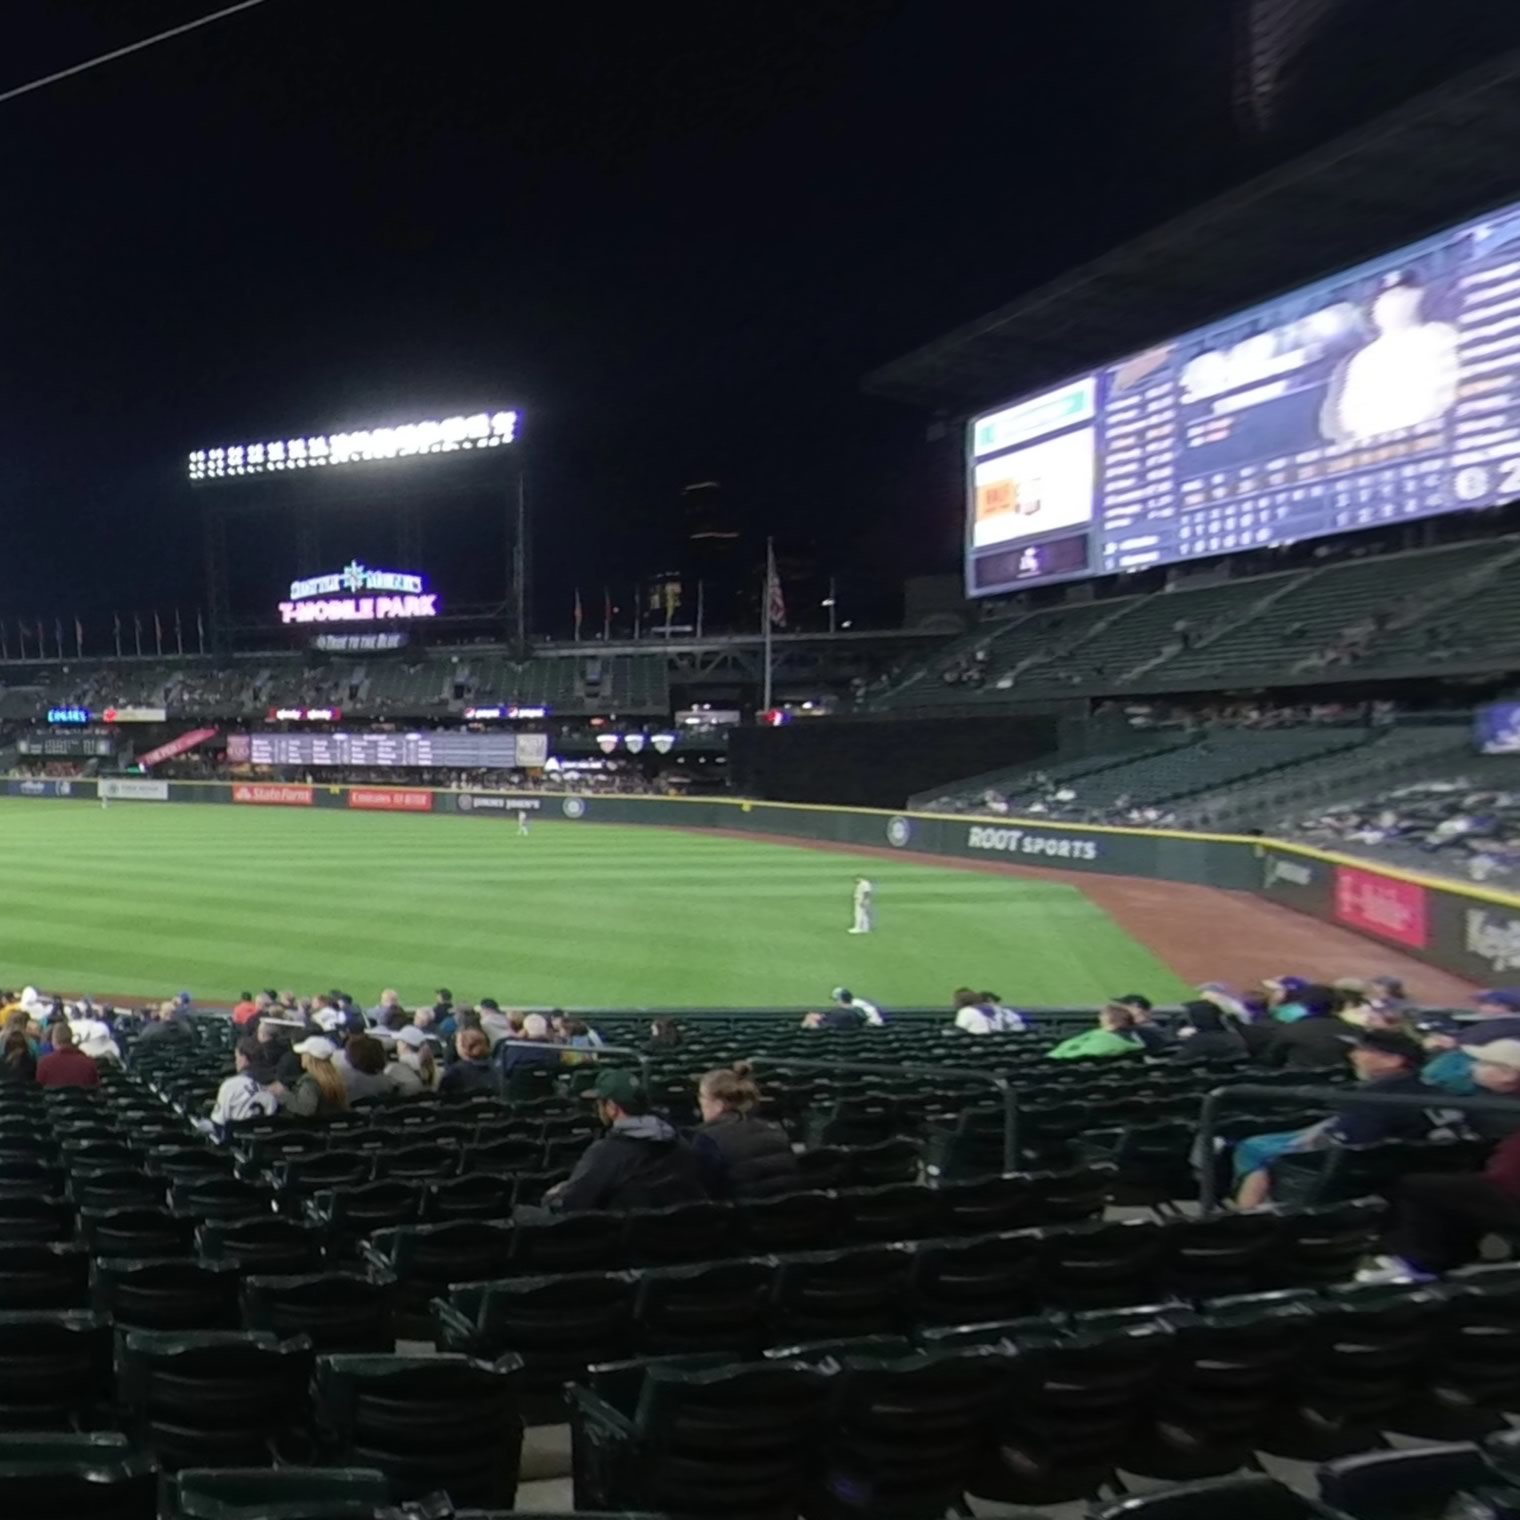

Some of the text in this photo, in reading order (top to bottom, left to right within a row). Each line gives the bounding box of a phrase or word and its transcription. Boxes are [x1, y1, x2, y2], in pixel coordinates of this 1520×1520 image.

[278, 595, 437, 623] T-MOBILE PARK
[968, 826, 1096, 860] ROOT SPORTS
